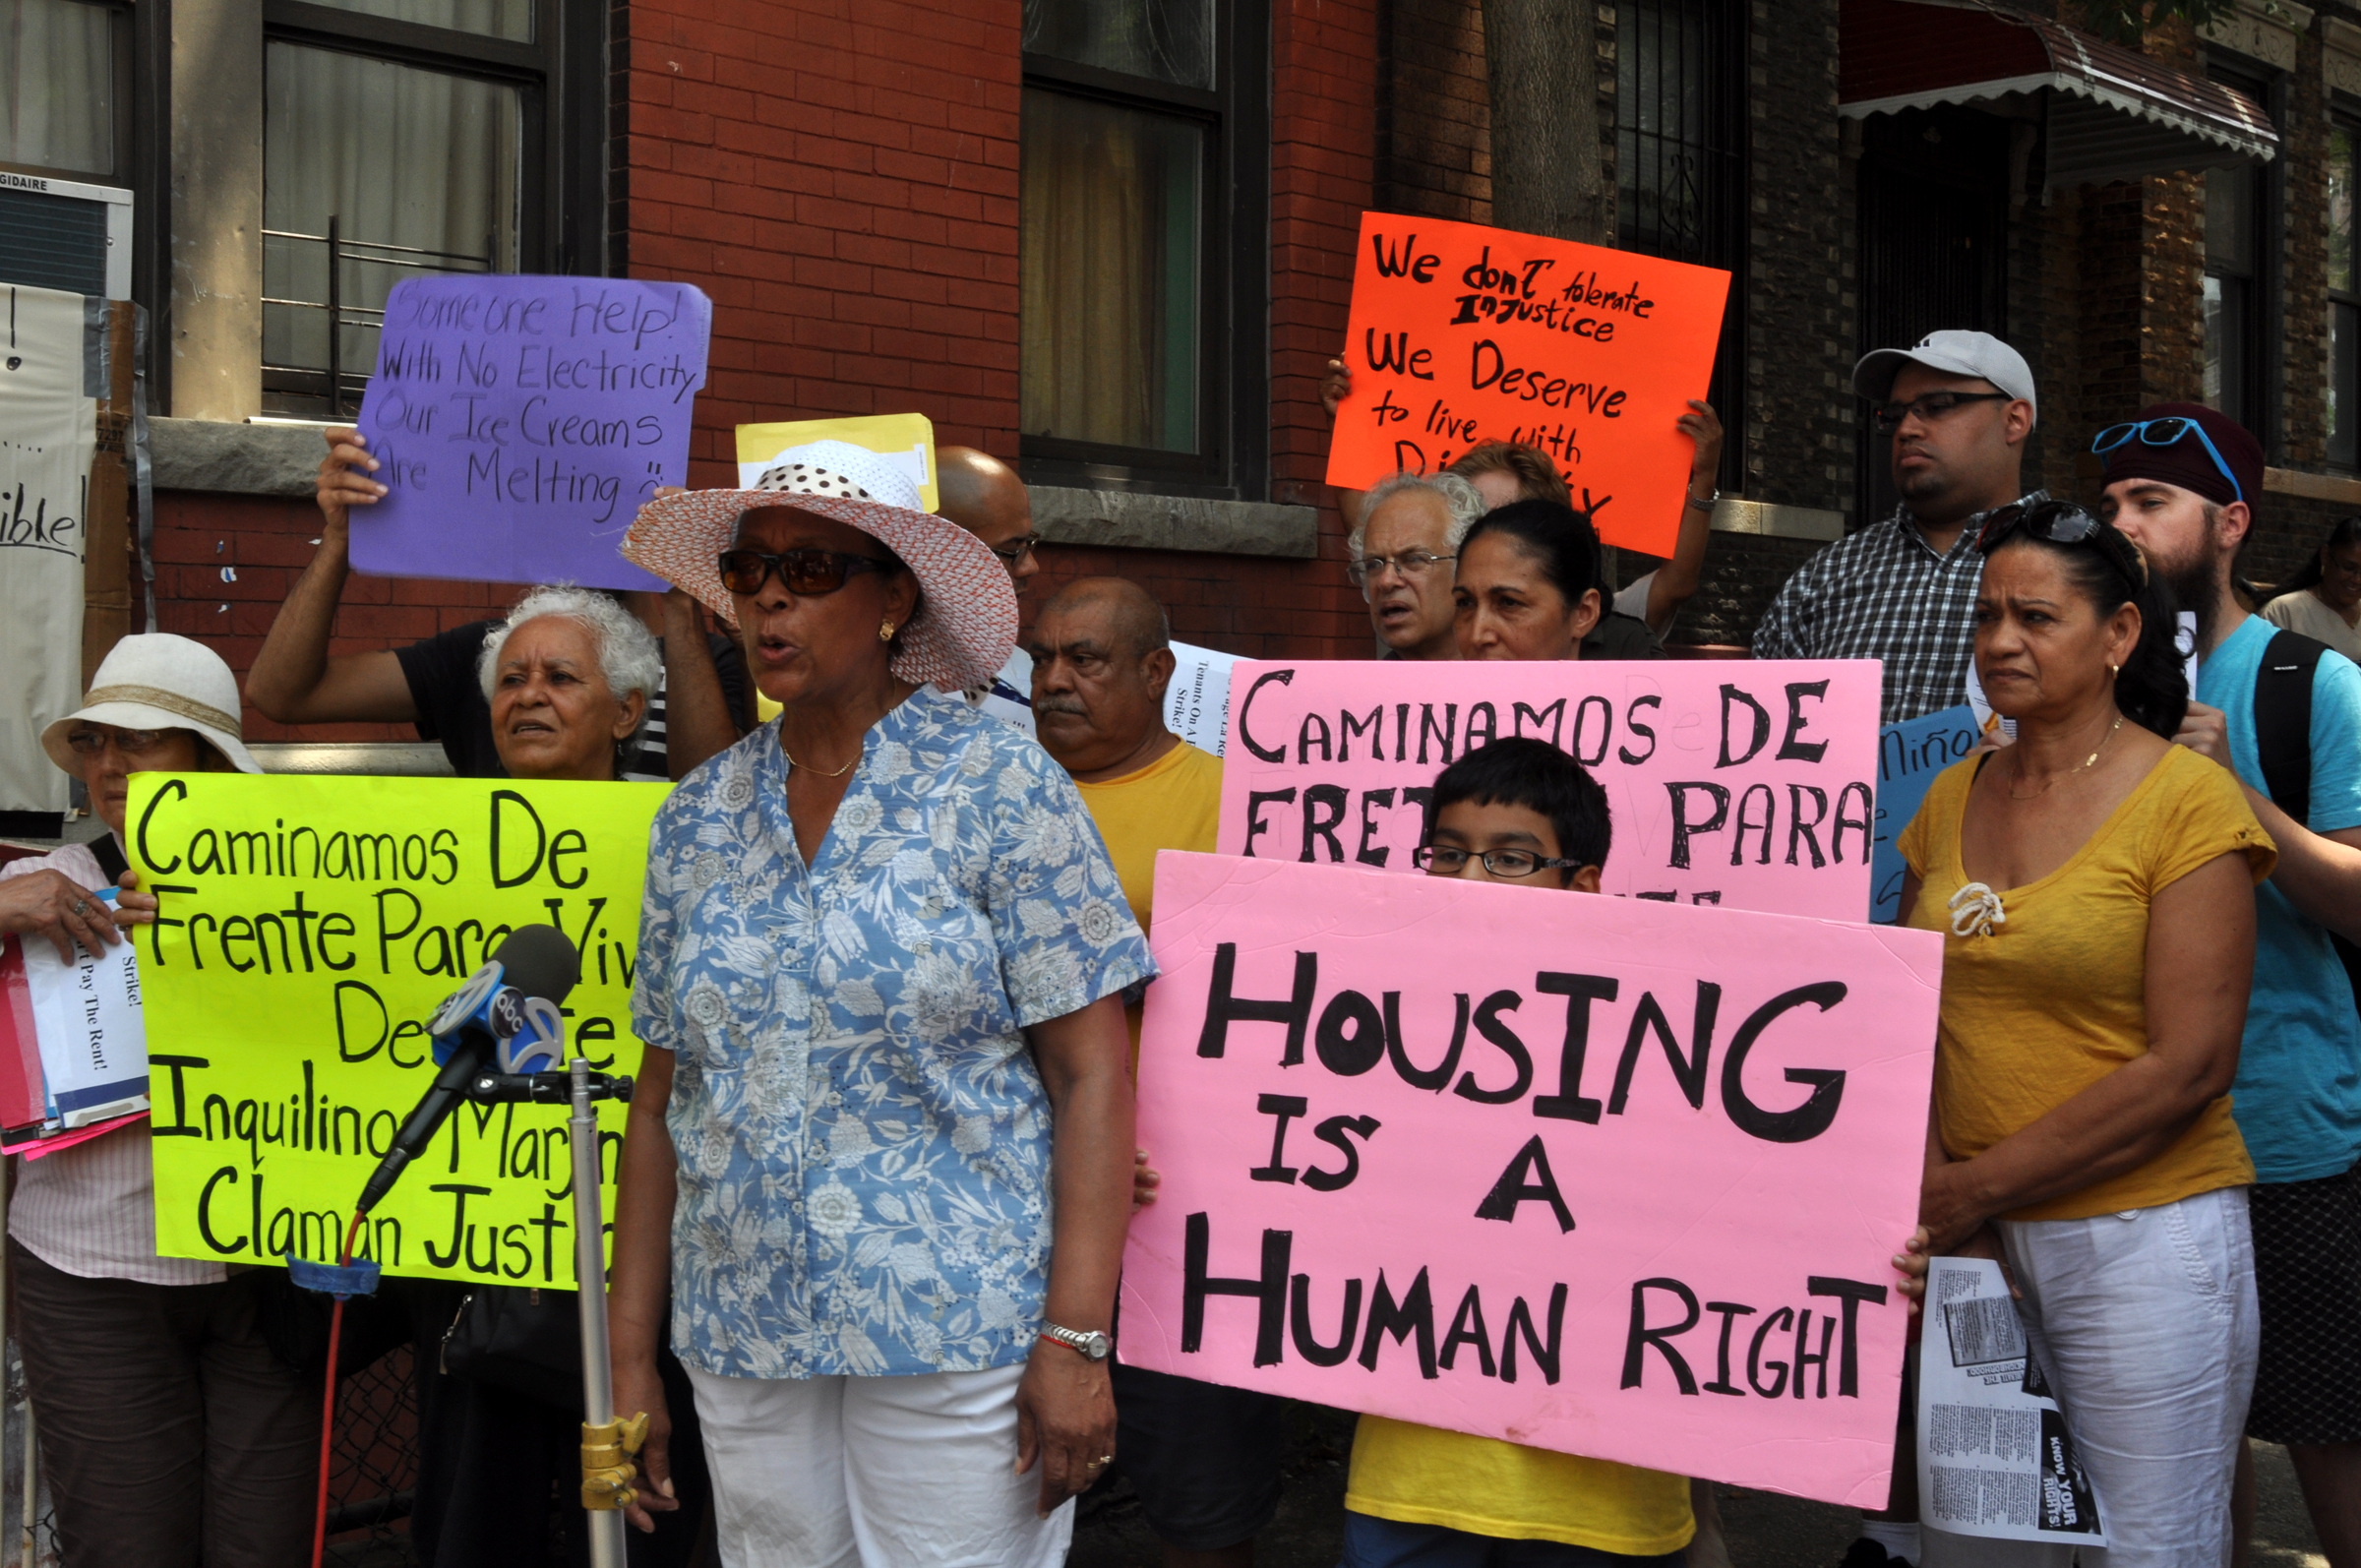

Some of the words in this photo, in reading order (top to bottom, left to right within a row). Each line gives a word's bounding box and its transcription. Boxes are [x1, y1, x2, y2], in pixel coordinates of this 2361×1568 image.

[1372, 233, 1441, 283] We
[1561, 271, 1655, 320] tolerate
[570, 285, 682, 350] Help!
[384, 338, 441, 383] With
[457, 340, 497, 388] No
[517, 344, 696, 404] Electricity
[1365, 327, 1434, 381] We
[1472, 339, 1627, 418] Deserve
[375, 389, 439, 435] Our
[448, 392, 510, 445] Ice
[521, 395, 663, 449] Creams
[1371, 390, 1409, 426] to
[1426, 399, 1478, 443] live
[368, 436, 427, 490] Are
[467, 447, 621, 523] Melting
[1172, 688, 1187, 728] Strike!
[1192, 661, 1209, 703] Tenants
[1186, 727, 1197, 736] A
[1188, 707, 1201, 725] On
[1239, 669, 1662, 767] CAMINAMOS
[1714, 679, 1831, 769] DE
[137, 779, 459, 885] Caminamos
[491, 789, 588, 889] De
[1663, 781, 1874, 871] PARA
[151, 883, 356, 974] Frente
[79, 964, 94, 992] Pay
[122, 956, 143, 1007] Strike!
[85, 995, 99, 1025] The
[497, 994, 523, 1033] abc
[89, 1029, 107, 1070] Rent!
[1196, 941, 1847, 1143] HOUSING
[149, 1054, 413, 1170] Inquilino
[1249, 1094, 1381, 1192] IS
[1474, 1134, 1576, 1235] A
[198, 1166, 400, 1267] Claman
[1180, 1211, 1569, 1386] HUMAN
[1620, 1276, 1887, 1400] RIGHT
[2049, 1436, 2066, 1476] KNOW
[2042, 1478, 2061, 1528] RIGHTS!
[2057, 1478, 2078, 1525] YOUR
